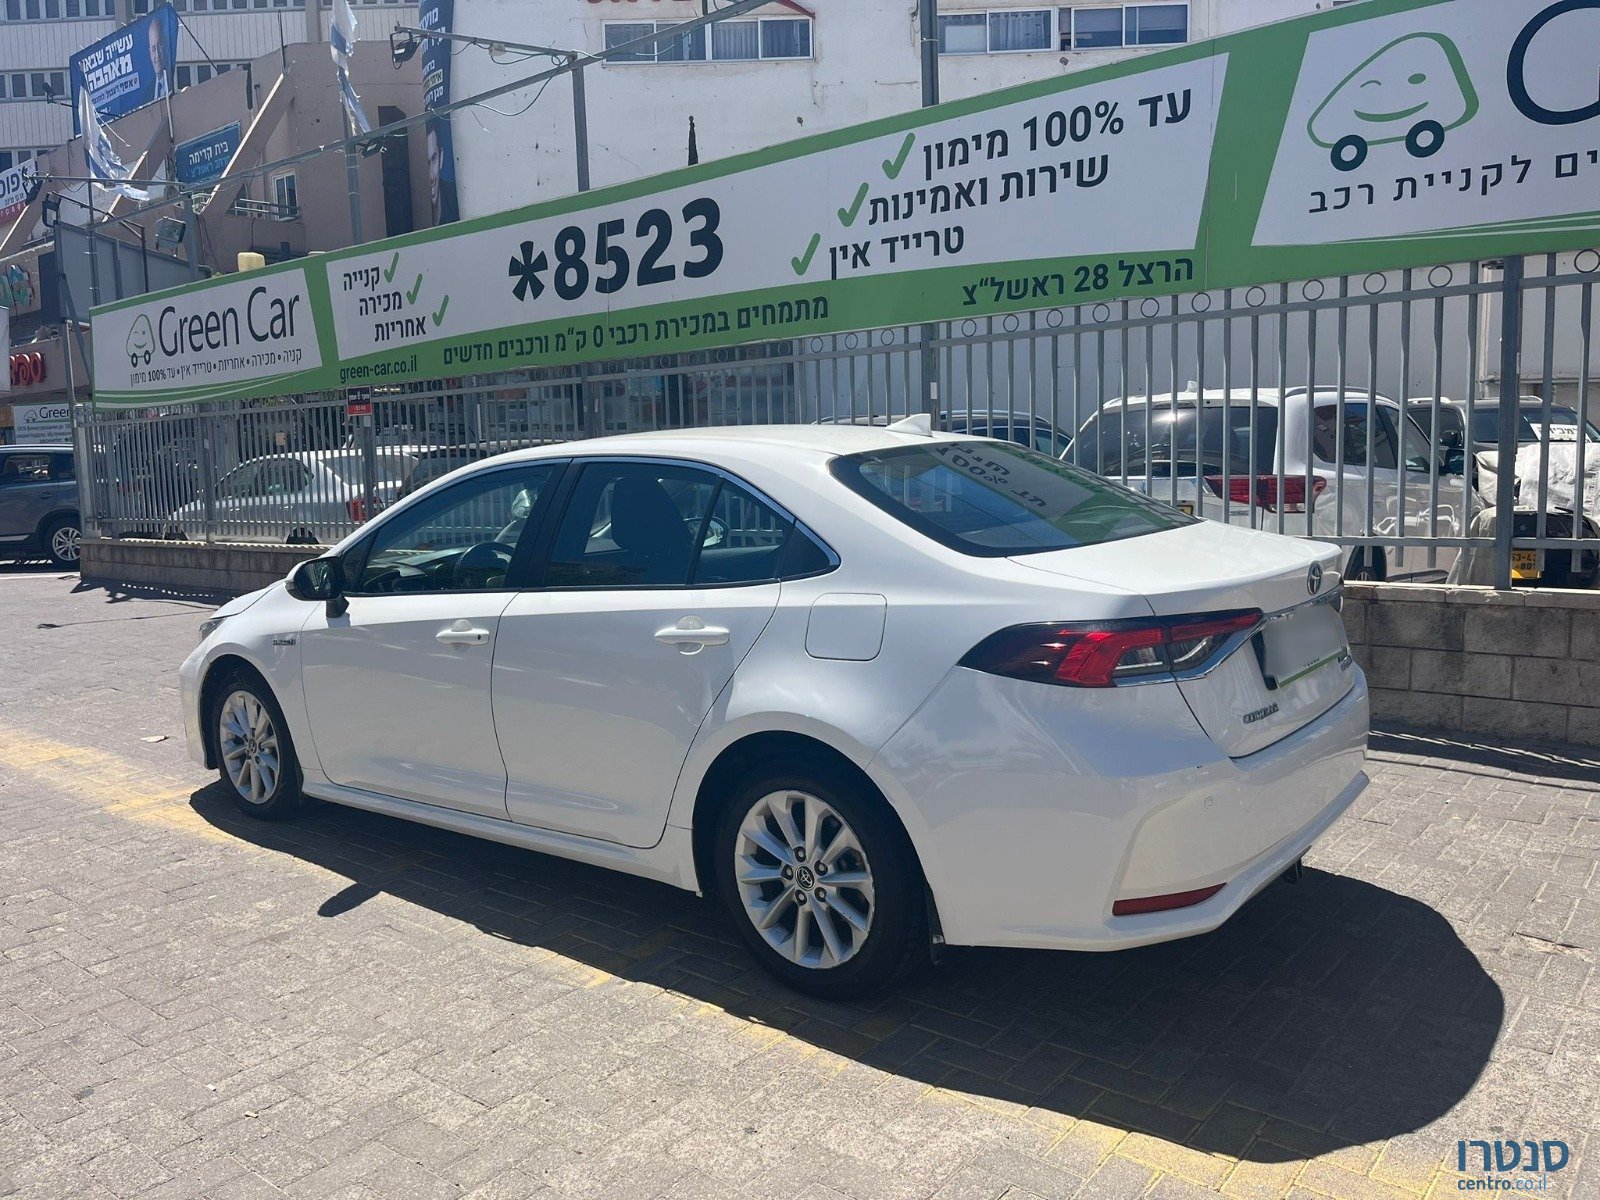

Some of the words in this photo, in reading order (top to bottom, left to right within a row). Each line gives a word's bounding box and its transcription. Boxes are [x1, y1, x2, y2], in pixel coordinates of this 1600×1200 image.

[87, 53, 133, 91] מאהבה
[1138, 87, 1192, 128] עד
[1023, 100, 1125, 152] 100%
[214, 141, 229, 156] בית
[923, 128, 1009, 181] מימון
[999, 154, 1109, 203] שירות
[1393, 154, 1532, 202] לקניית
[868, 177, 988, 226] ואמינות
[1308, 183, 1375, 214] רכב
[880, 225, 965, 264] טרייד
[829, 239, 872, 281] אין
[1118, 257, 1194, 287] הרצל
[343, 266, 380, 292] קנייה
[1073, 263, 1110, 293] 28
[359, 290, 403, 317] מכירה
[737, 296, 830, 329] מתמחים
[158, 306, 240, 357] Green
[247, 286, 300, 342] Car
[374, 315, 427, 343] אחריות
[592, 324, 603, 349] 0
[608, 319, 649, 347] רכבי
[654, 309, 731, 342] במכירת
[251, 351, 276, 367] מכירה
[283, 348, 302, 365] קניה
[443, 341, 493, 366] חדשים
[498, 334, 549, 359] ורכבים
[148, 368, 167, 382] 100%
[218, 356, 245, 372] אחריות
[340, 354, 417, 384] green-car.co.il
